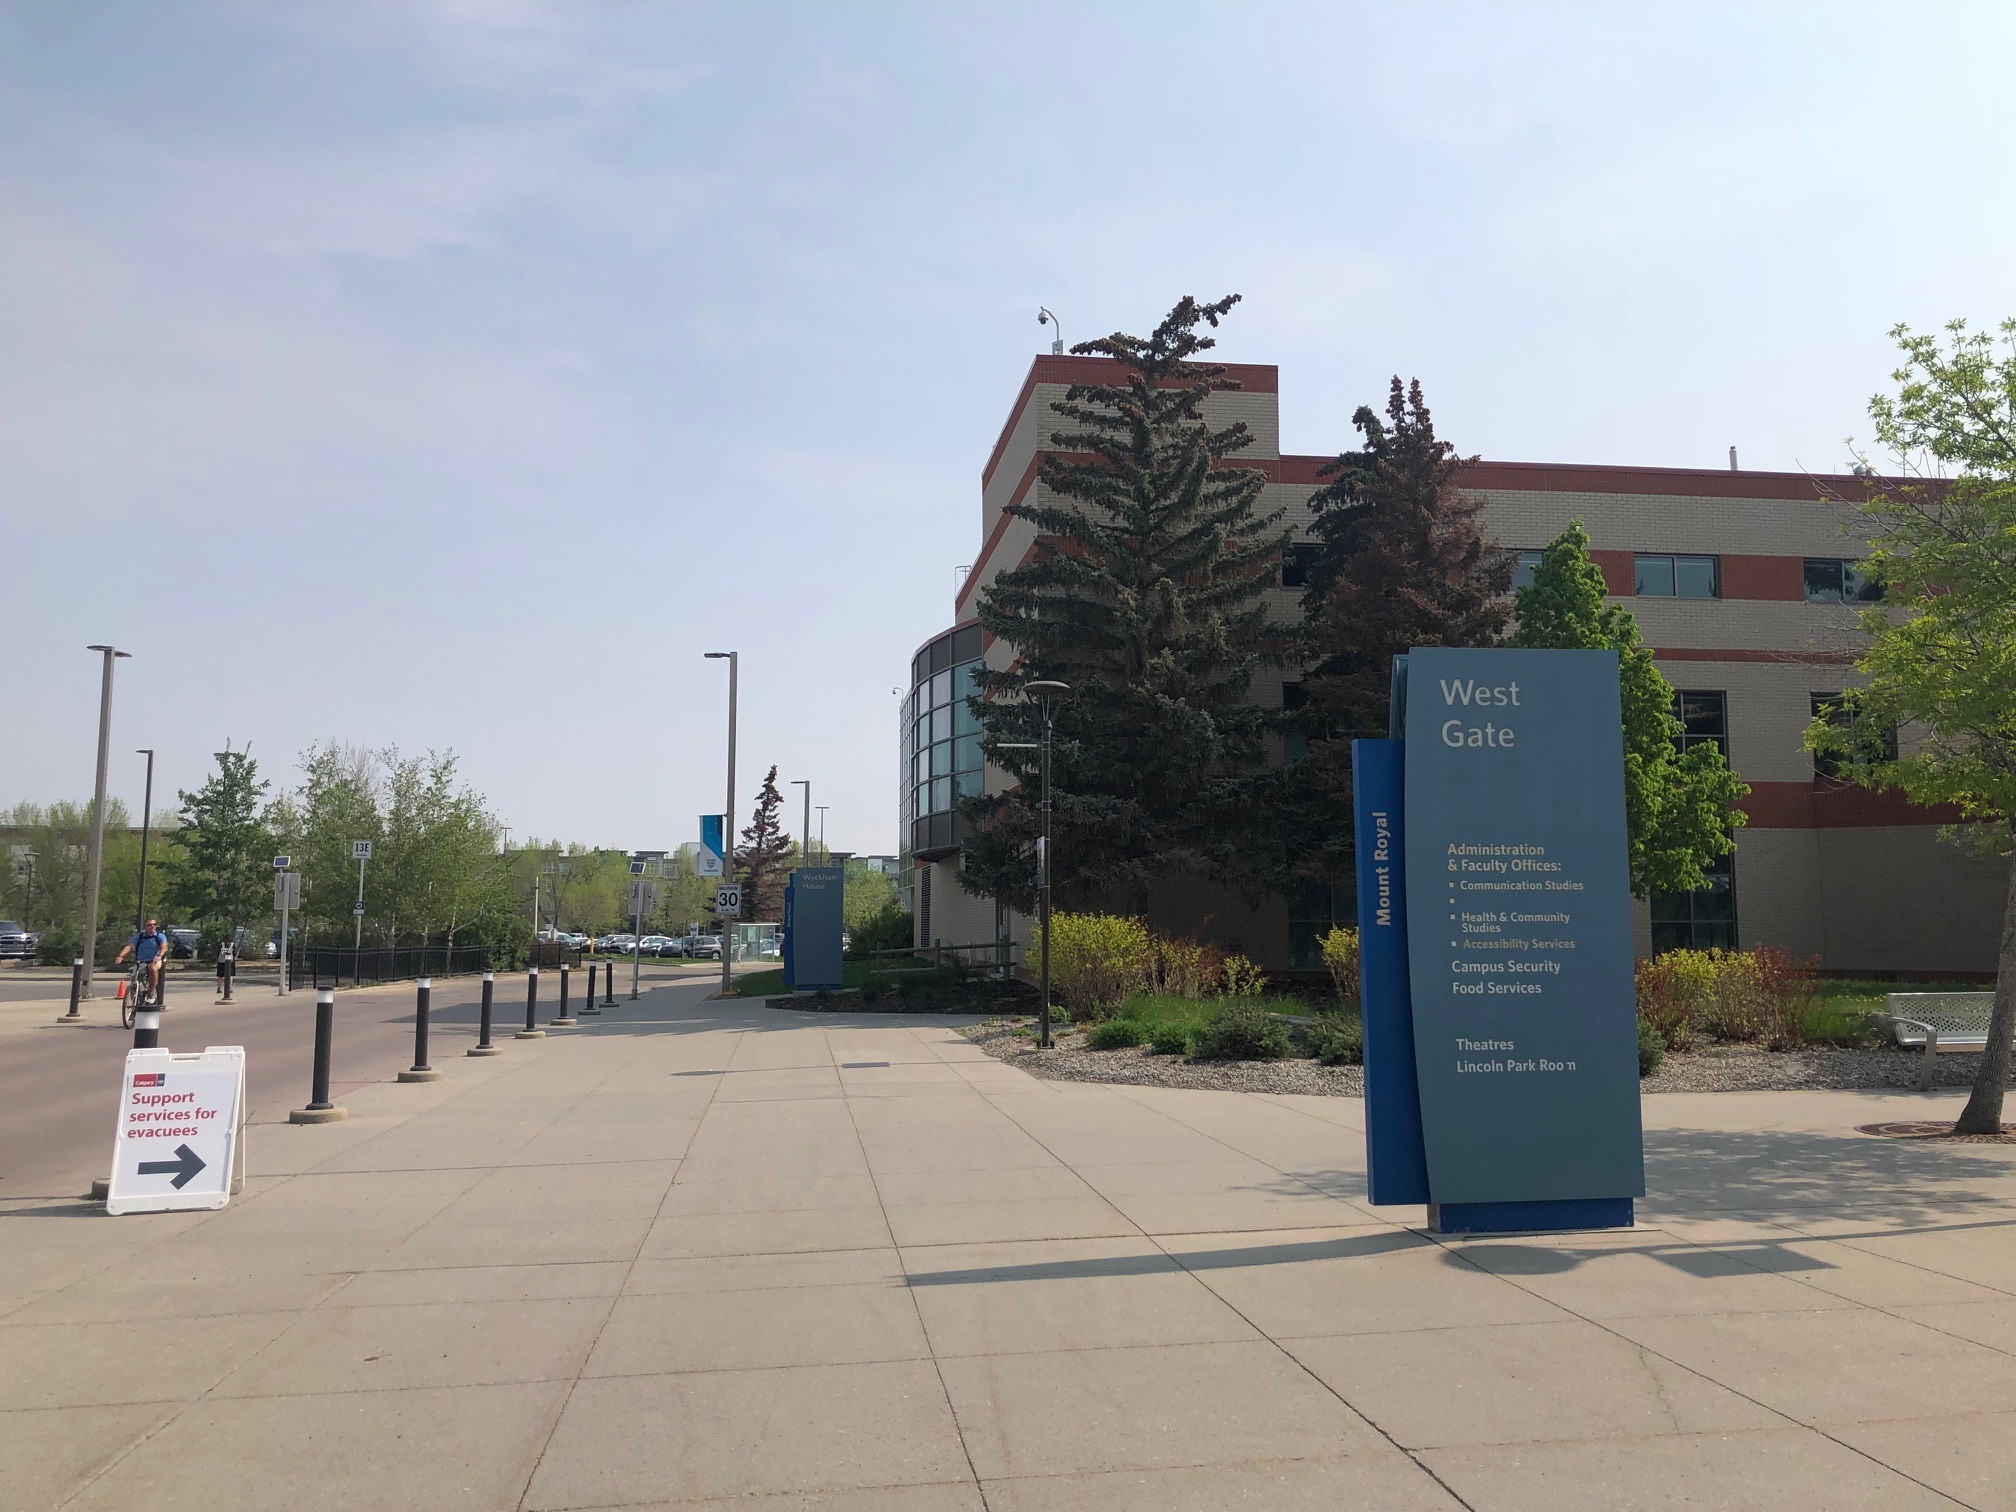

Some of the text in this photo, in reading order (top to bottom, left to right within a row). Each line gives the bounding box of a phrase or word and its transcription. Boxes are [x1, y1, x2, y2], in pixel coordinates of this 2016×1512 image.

[1440, 678, 1520, 707] West
[1441, 719, 1515, 748] Gate
[355, 843, 369, 852] 13E
[1447, 843, 1545, 856] Administration
[1371, 811, 1392, 926] Mount Royal
[1447, 859, 1562, 873] & Faculty Offices:
[802, 874, 838, 882] Wyckham
[1460, 880, 1584, 891] Communication Studies
[719, 892, 738, 906] 30
[1461, 912, 1570, 925] Health & Community
[1461, 923, 1502, 933] Studies
[1463, 939, 1576, 951] Accessibility Services
[1451, 960, 1561, 974] Campus Security
[1452, 982, 1542, 995] Food Services
[1456, 1038, 1514, 1051] Theatres
[1457, 1059, 1503, 1073] Lincoln
[1507, 1059, 1536, 1072] Park
[131, 1092, 195, 1106] Support
[129, 1107, 218, 1122] services for
[127, 1126, 198, 1139] evacuees
